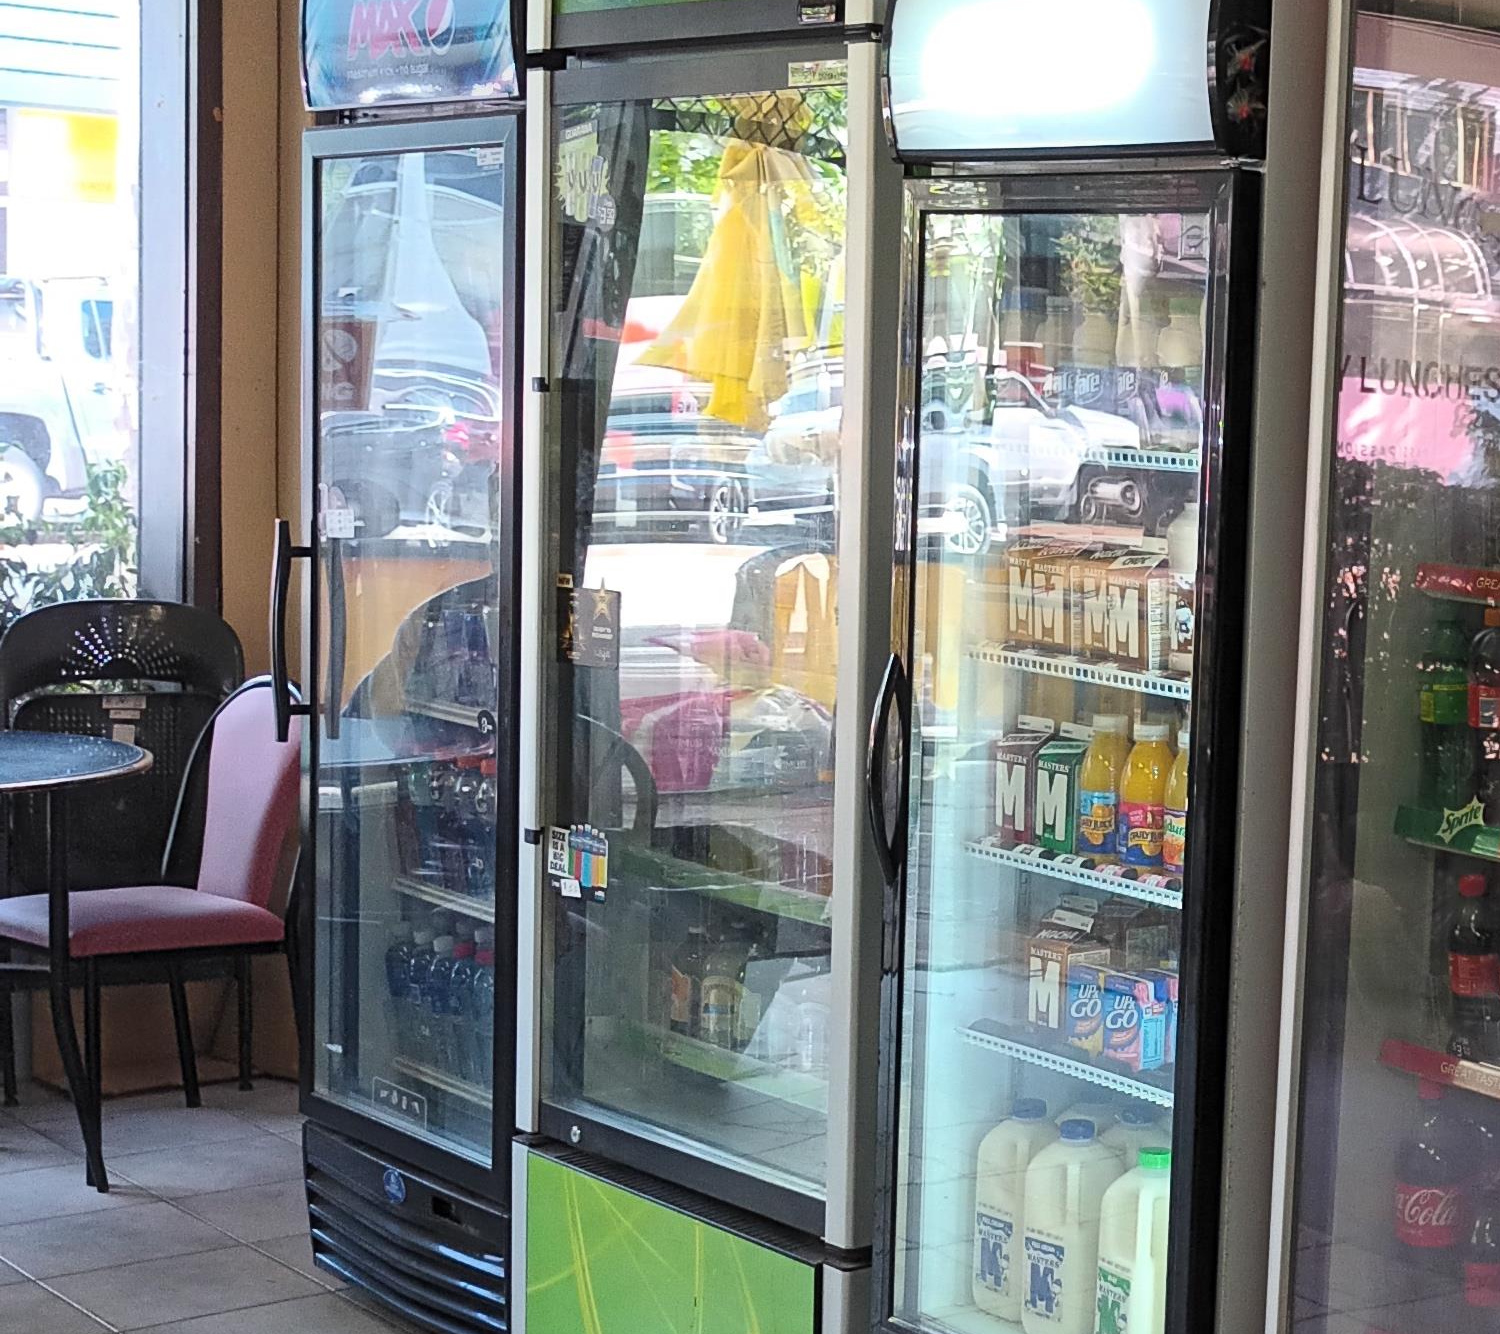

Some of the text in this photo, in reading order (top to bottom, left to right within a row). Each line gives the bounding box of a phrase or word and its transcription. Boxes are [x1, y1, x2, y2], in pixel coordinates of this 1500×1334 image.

[996, 751, 1028, 764] MASTERS
[1038, 760, 1070, 773] MASTERS
[995, 760, 1026, 832] M
[1035, 769, 1068, 841] M
[1441, 805, 1482, 835] Sprite
[1028, 956, 1061, 1029] M
[1070, 998, 1101, 1018] GO
[1105, 1010, 1139, 1029] GO
[1439, 1061, 1474, 1080] GREAT
